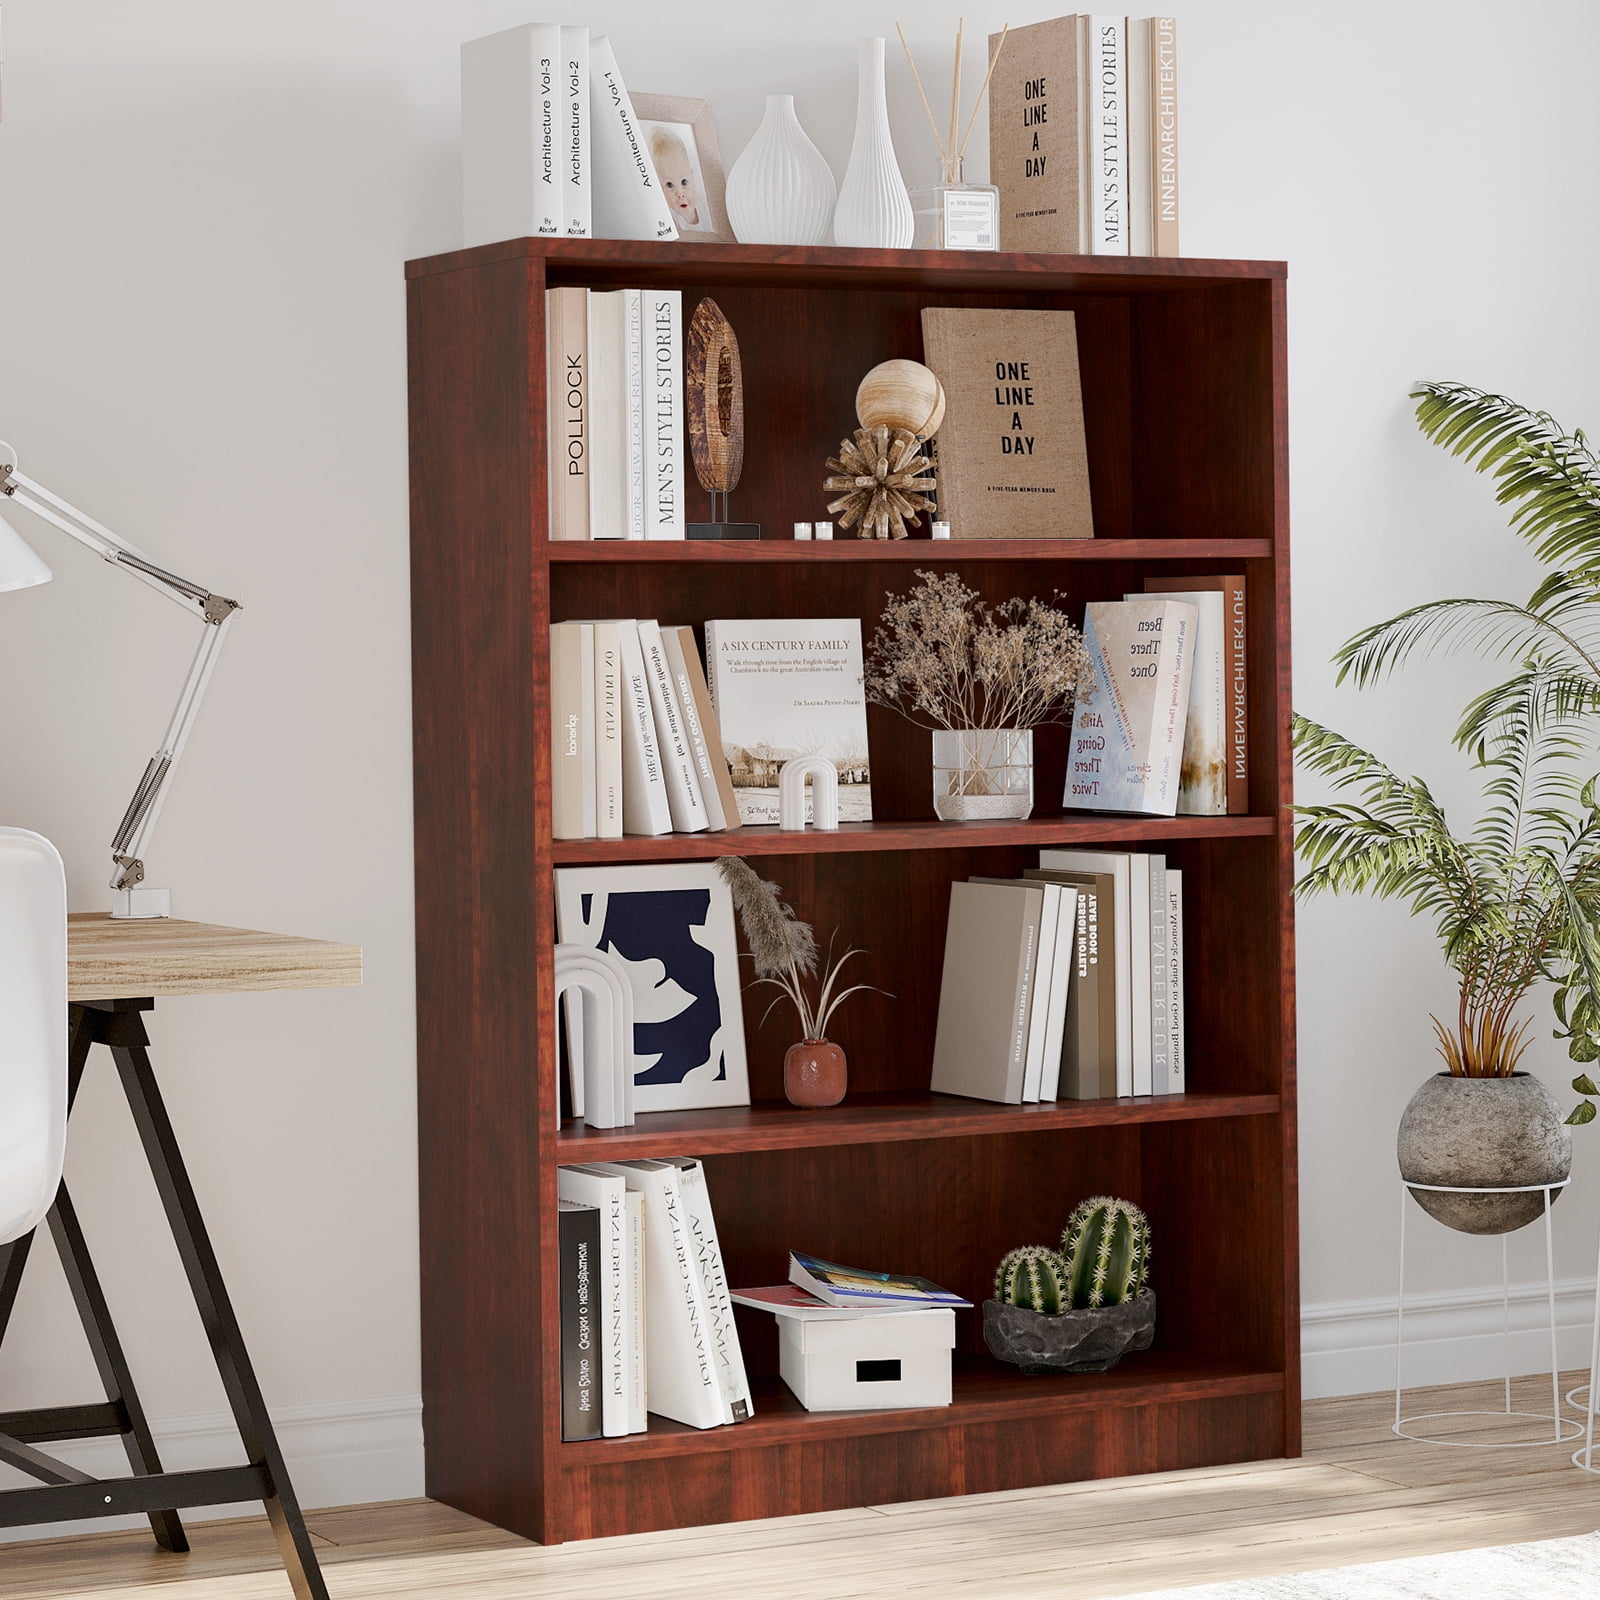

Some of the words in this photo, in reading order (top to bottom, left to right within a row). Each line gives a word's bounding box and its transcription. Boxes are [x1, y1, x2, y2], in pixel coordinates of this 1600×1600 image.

[540, 58, 551, 95] Vol-3
[569, 61, 579, 97] Vol-2
[1101, 25, 1117, 110] STORIES
[604, 71, 622, 107] Vol-1
[1025, 78, 1046, 100] ONE
[1023, 104, 1048, 127] LINE
[1160, 17, 1176, 222] INNENARCHITEKTUR
[541, 100, 552, 184] Architecture
[570, 101, 581, 185] Architecture
[618, 109, 653, 187] Architecture
[1032, 131, 1039, 151] A
[1103, 115, 1118, 178] STYLE
[1026, 156, 1047, 178] DAY
[1104, 183, 1119, 243] MEN'S
[631, 296, 641, 398] REVOLUTION
[655, 301, 673, 388] STORIES
[996, 362, 1030, 381] ONE
[566, 353, 584, 476] POLLOCK
[995, 387, 1035, 405] LINE
[632, 404, 641, 447] LOOK
[657, 394, 674, 457] STYLE
[1011, 411, 1023, 430] A
[1001, 436, 1035, 455] DAY
[632, 453, 642, 486] NEW
[658, 463, 675, 525] MEN'S
[721, 641, 729, 651] A
[731, 641, 750, 651] SIX
[751, 640, 805, 651] CENTURY
[808, 640, 850, 650] FAMILY
[578, 1316, 591, 1350] Сказки
[612, 1293, 623, 1397] JOHANNES
[683, 1282, 712, 1387] JOHANNES
[578, 1359, 592, 1387] Бялко
[578, 1390, 591, 1412] Анна
